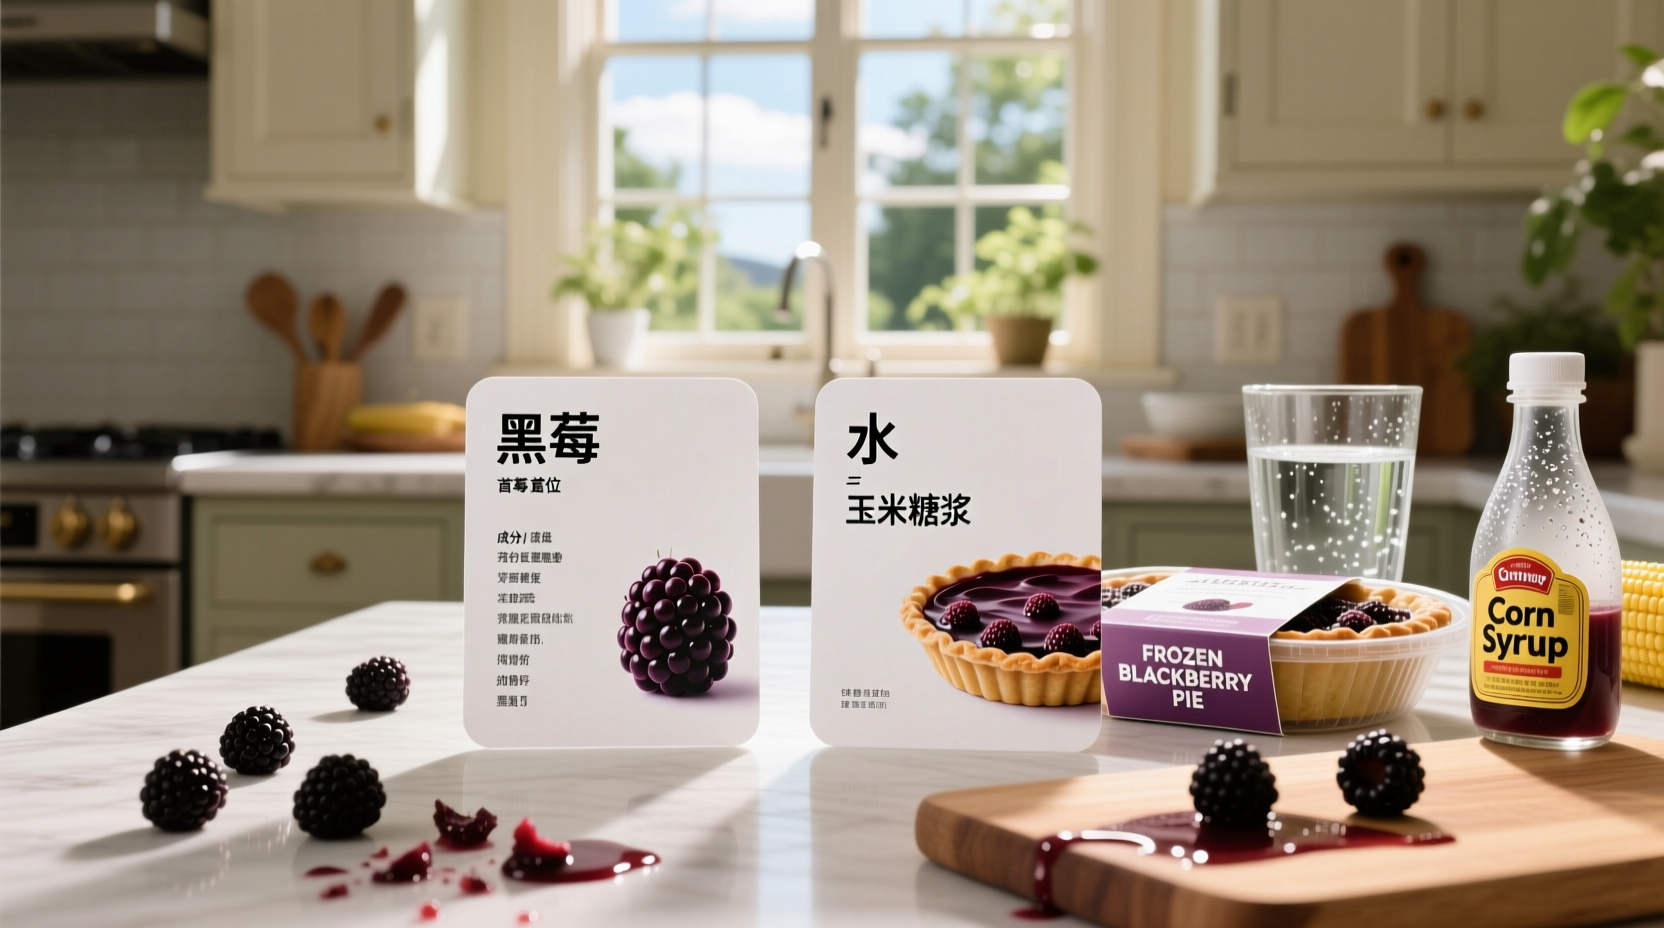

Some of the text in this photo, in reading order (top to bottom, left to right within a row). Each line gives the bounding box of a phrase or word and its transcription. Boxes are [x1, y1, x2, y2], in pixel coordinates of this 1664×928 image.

[497, 412, 599, 464] 黑莓
[847, 412, 898, 465] 水
[846, 493, 971, 526] 玉米糖浆
[1488, 597, 1554, 628] Corn
[1142, 644, 1223, 668] FROZEN
[1483, 624, 1568, 664] Syrup
[1118, 663, 1253, 692] BLACKBERRY
[1172, 689, 1205, 710] PIE
